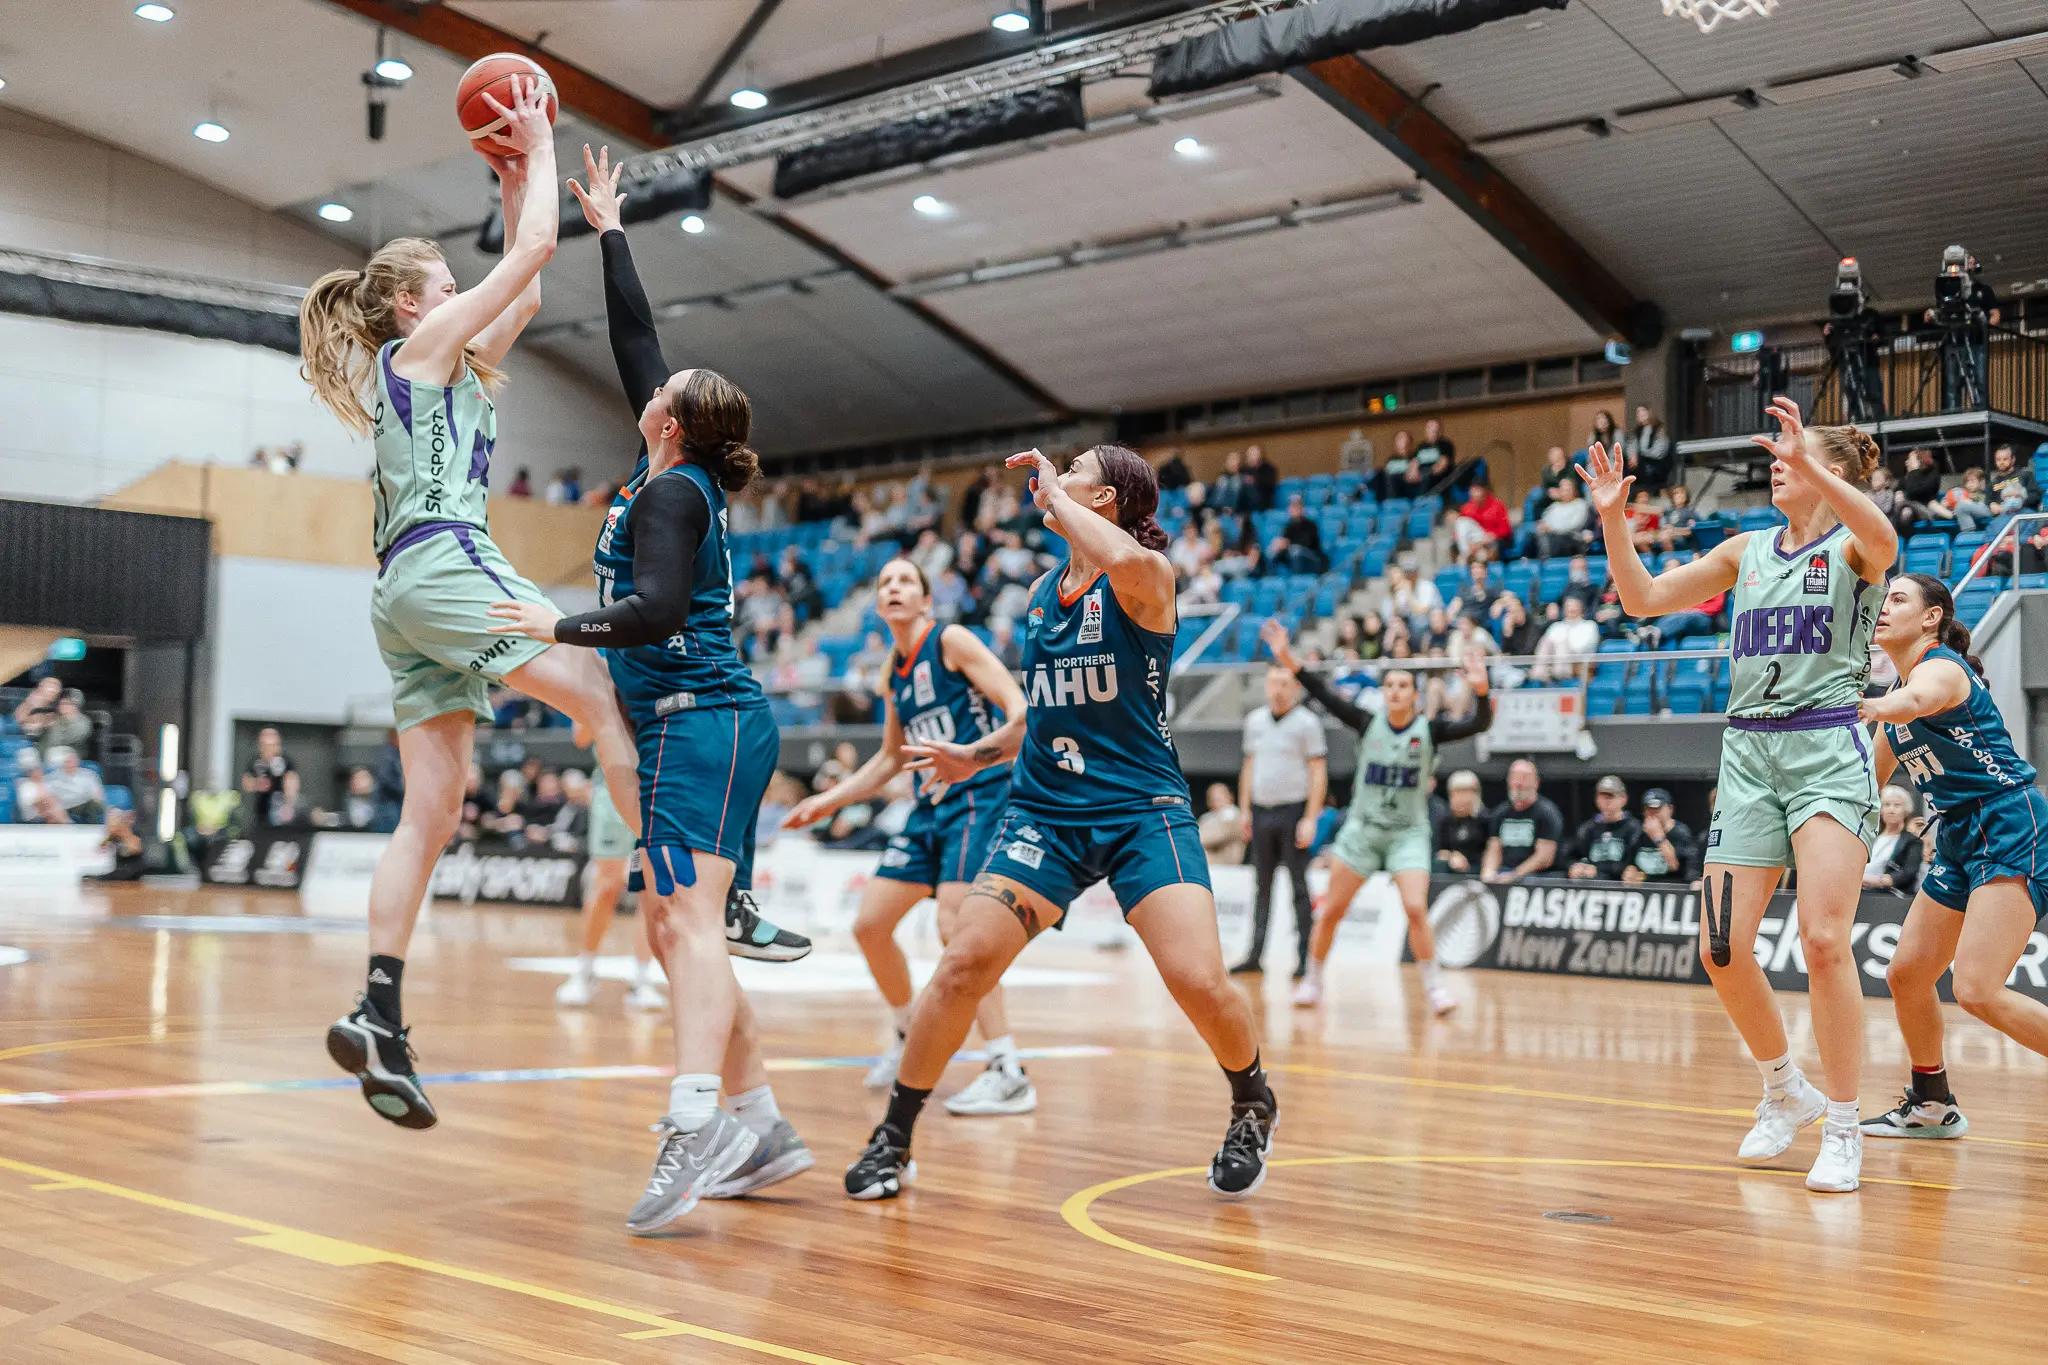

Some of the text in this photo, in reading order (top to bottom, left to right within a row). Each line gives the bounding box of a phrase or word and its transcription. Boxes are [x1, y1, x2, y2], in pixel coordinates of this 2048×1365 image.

[1733, 605, 1834, 664] QUEENS
[1054, 653, 1115, 669] NORTHERN
[1762, 660, 1782, 700] 2
[1052, 736, 1086, 775] 3
[1503, 886, 1699, 936] BASKETBALL
[1498, 928, 1699, 979] New Zealand
